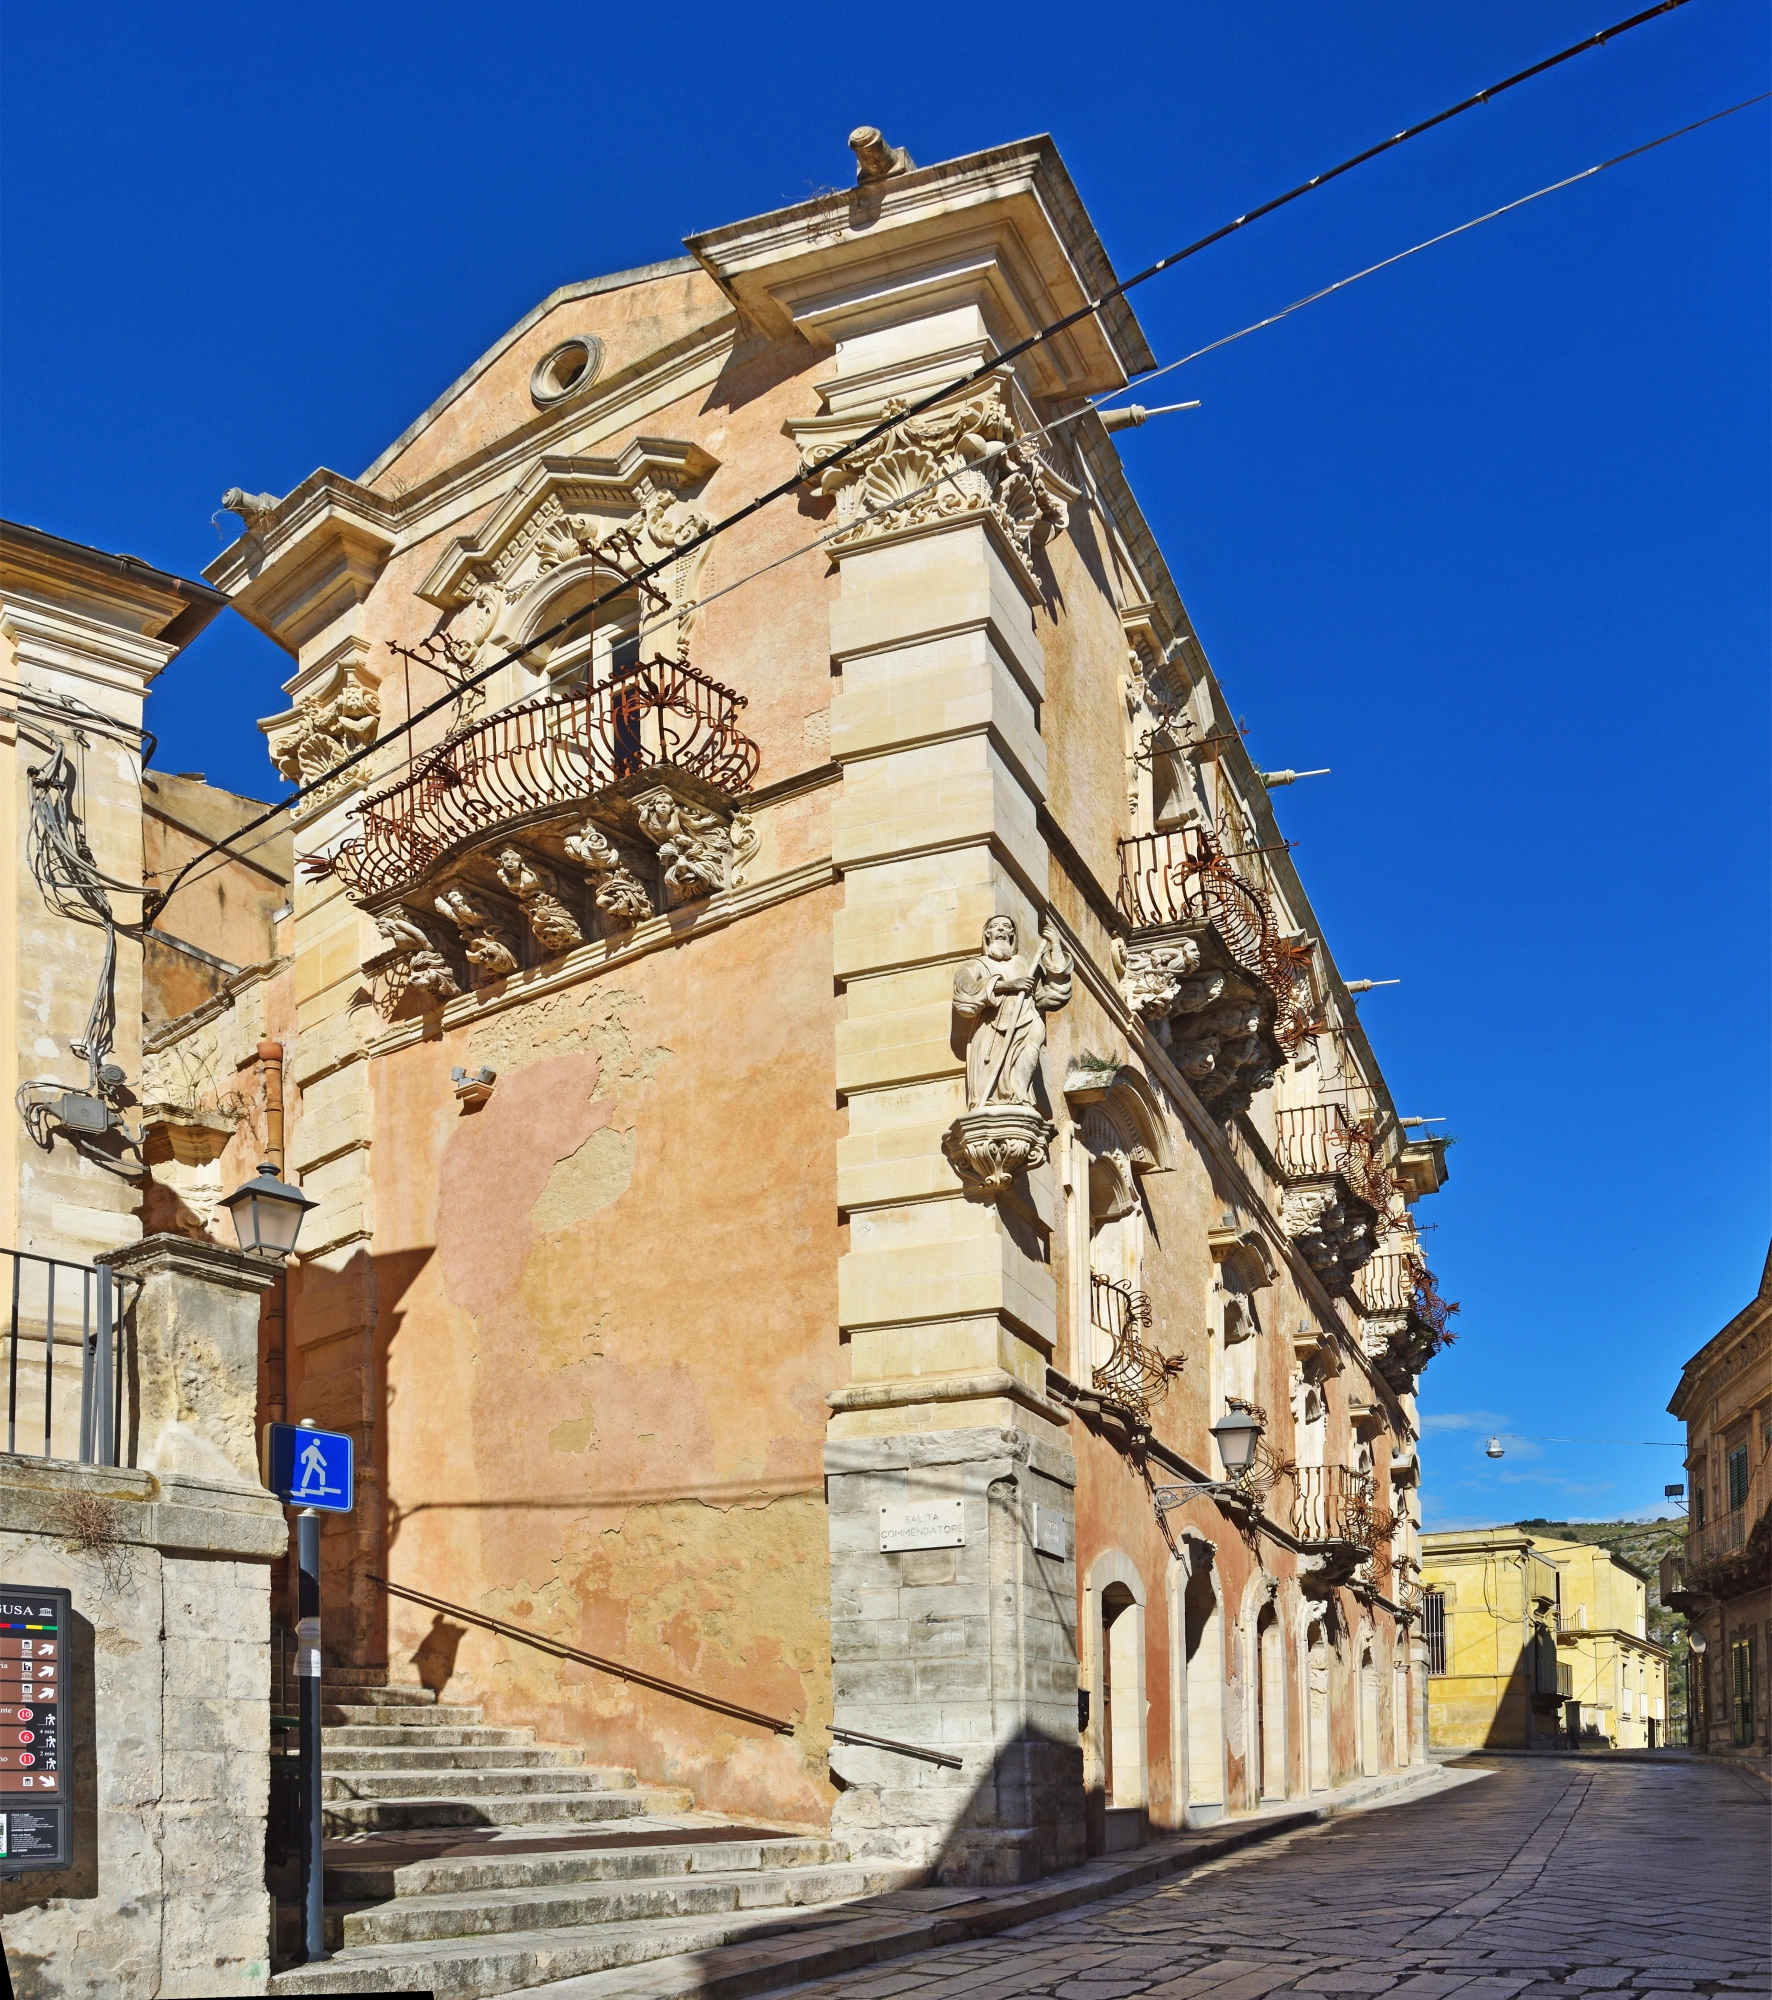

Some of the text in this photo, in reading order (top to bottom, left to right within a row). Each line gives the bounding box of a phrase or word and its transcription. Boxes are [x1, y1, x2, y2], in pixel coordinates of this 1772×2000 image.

[904, 1513, 940, 1524] SALITA
[880, 1524, 963, 1539] COMMENDATORE
[0, 1604, 34, 1615] USA
